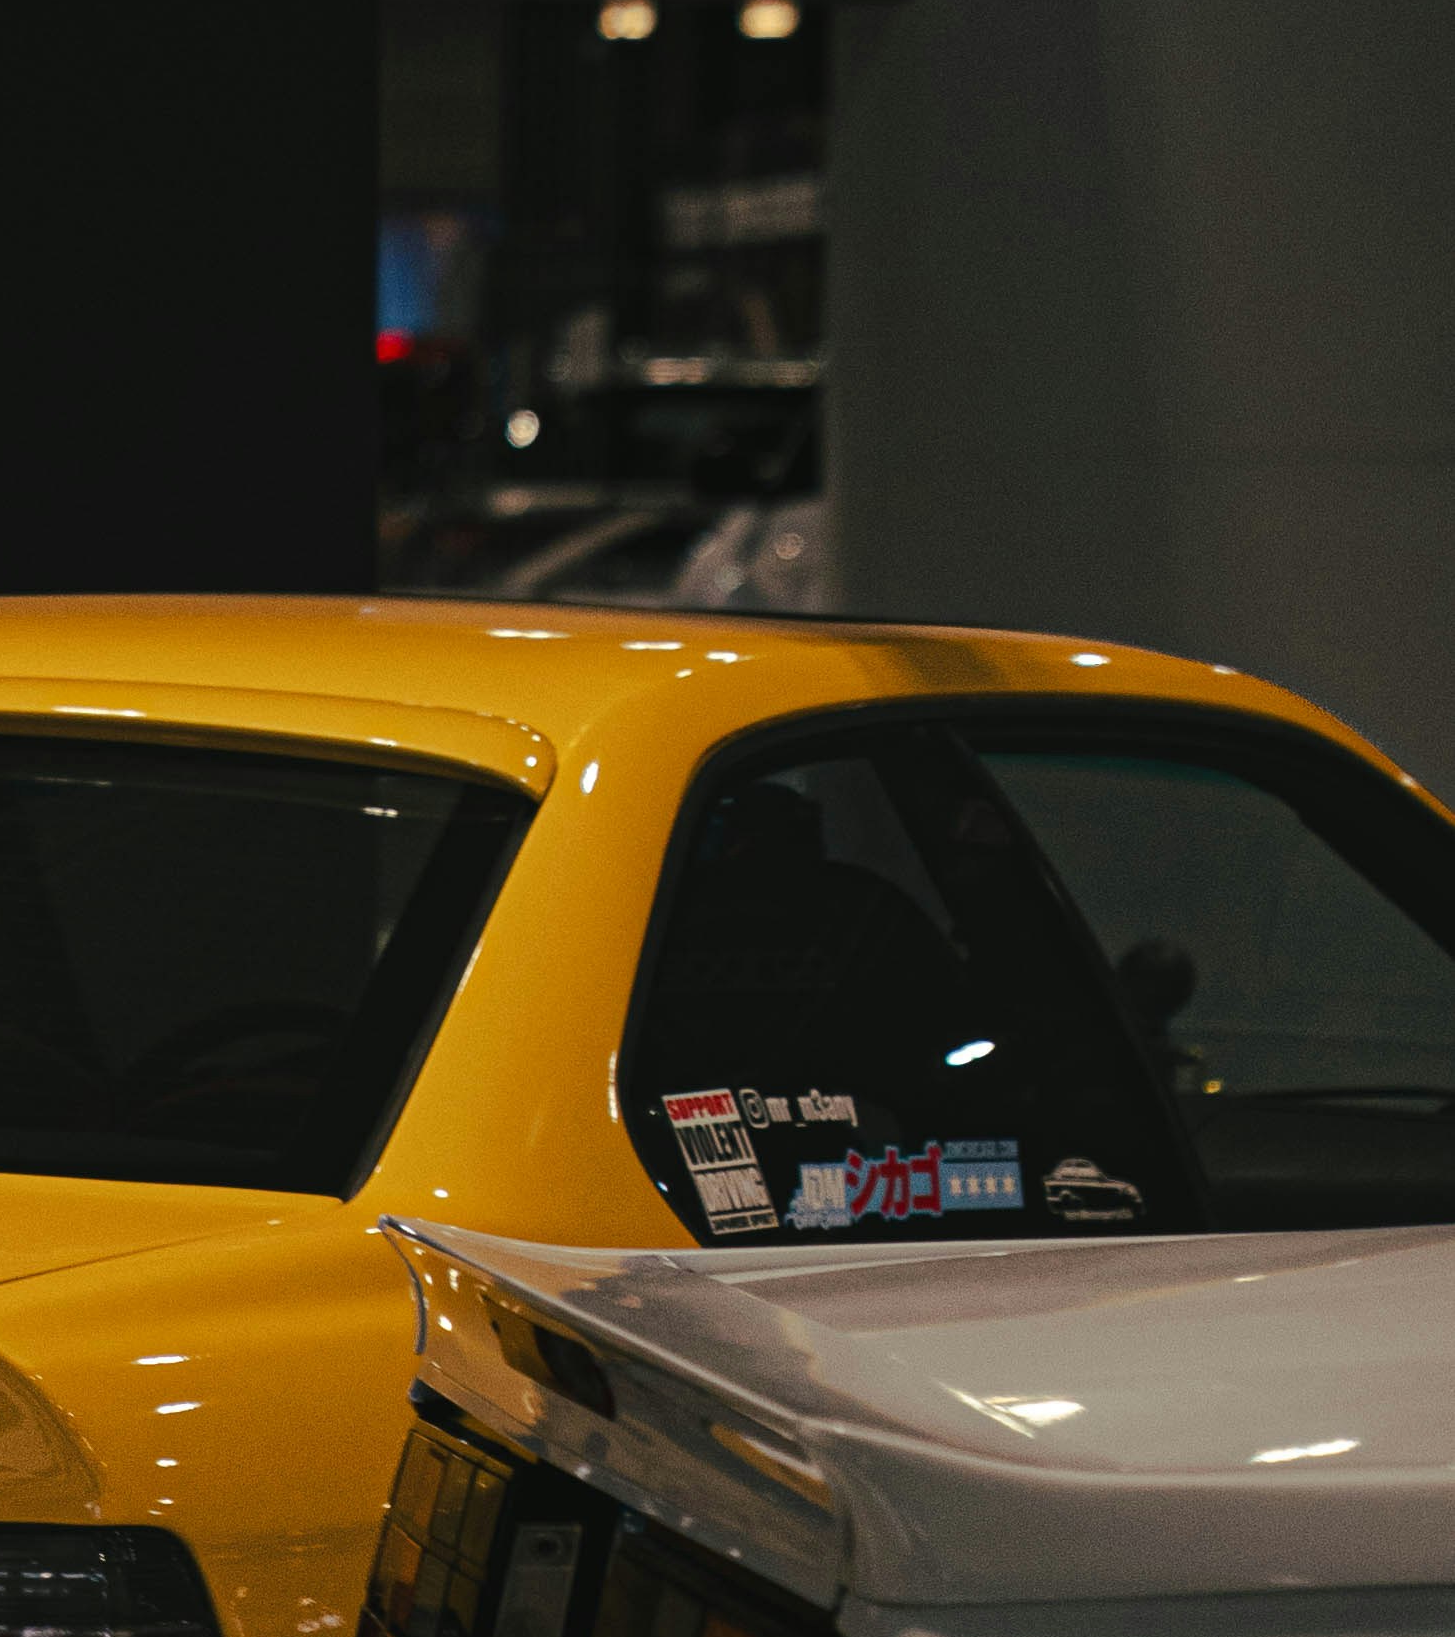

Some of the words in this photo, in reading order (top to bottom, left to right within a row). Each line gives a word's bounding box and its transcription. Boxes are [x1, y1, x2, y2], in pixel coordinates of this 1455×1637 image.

[665, 1094, 734, 1121] SUPPORT
[675, 1121, 755, 1165] VIOLENT
[693, 1166, 770, 1212] DRIVING
[846, 1144, 942, 1216] シカゴ
